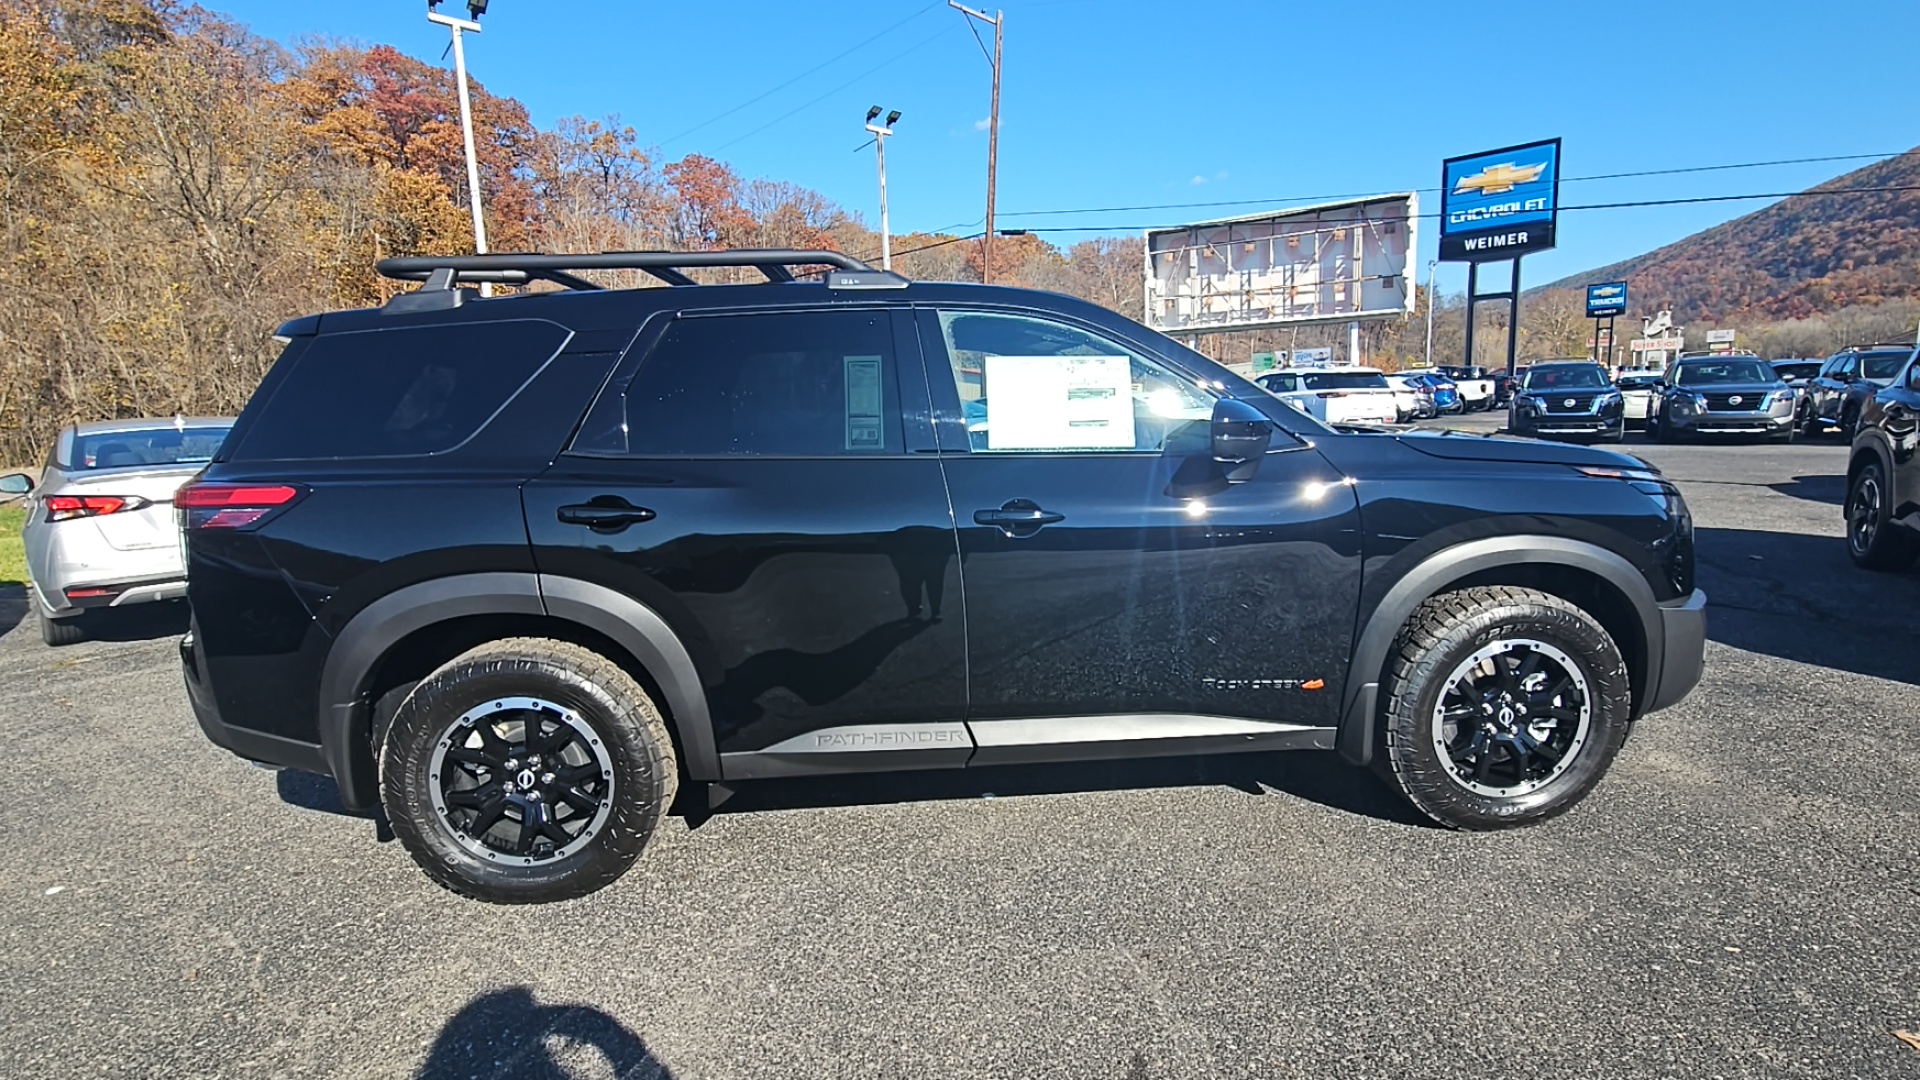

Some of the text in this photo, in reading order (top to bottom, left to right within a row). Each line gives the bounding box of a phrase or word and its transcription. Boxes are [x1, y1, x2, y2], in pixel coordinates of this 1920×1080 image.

[1450, 197, 1547, 224] CHEVROLET
[1464, 231, 1529, 251] WEIMER
[815, 730, 965, 748] PATHFINDER
